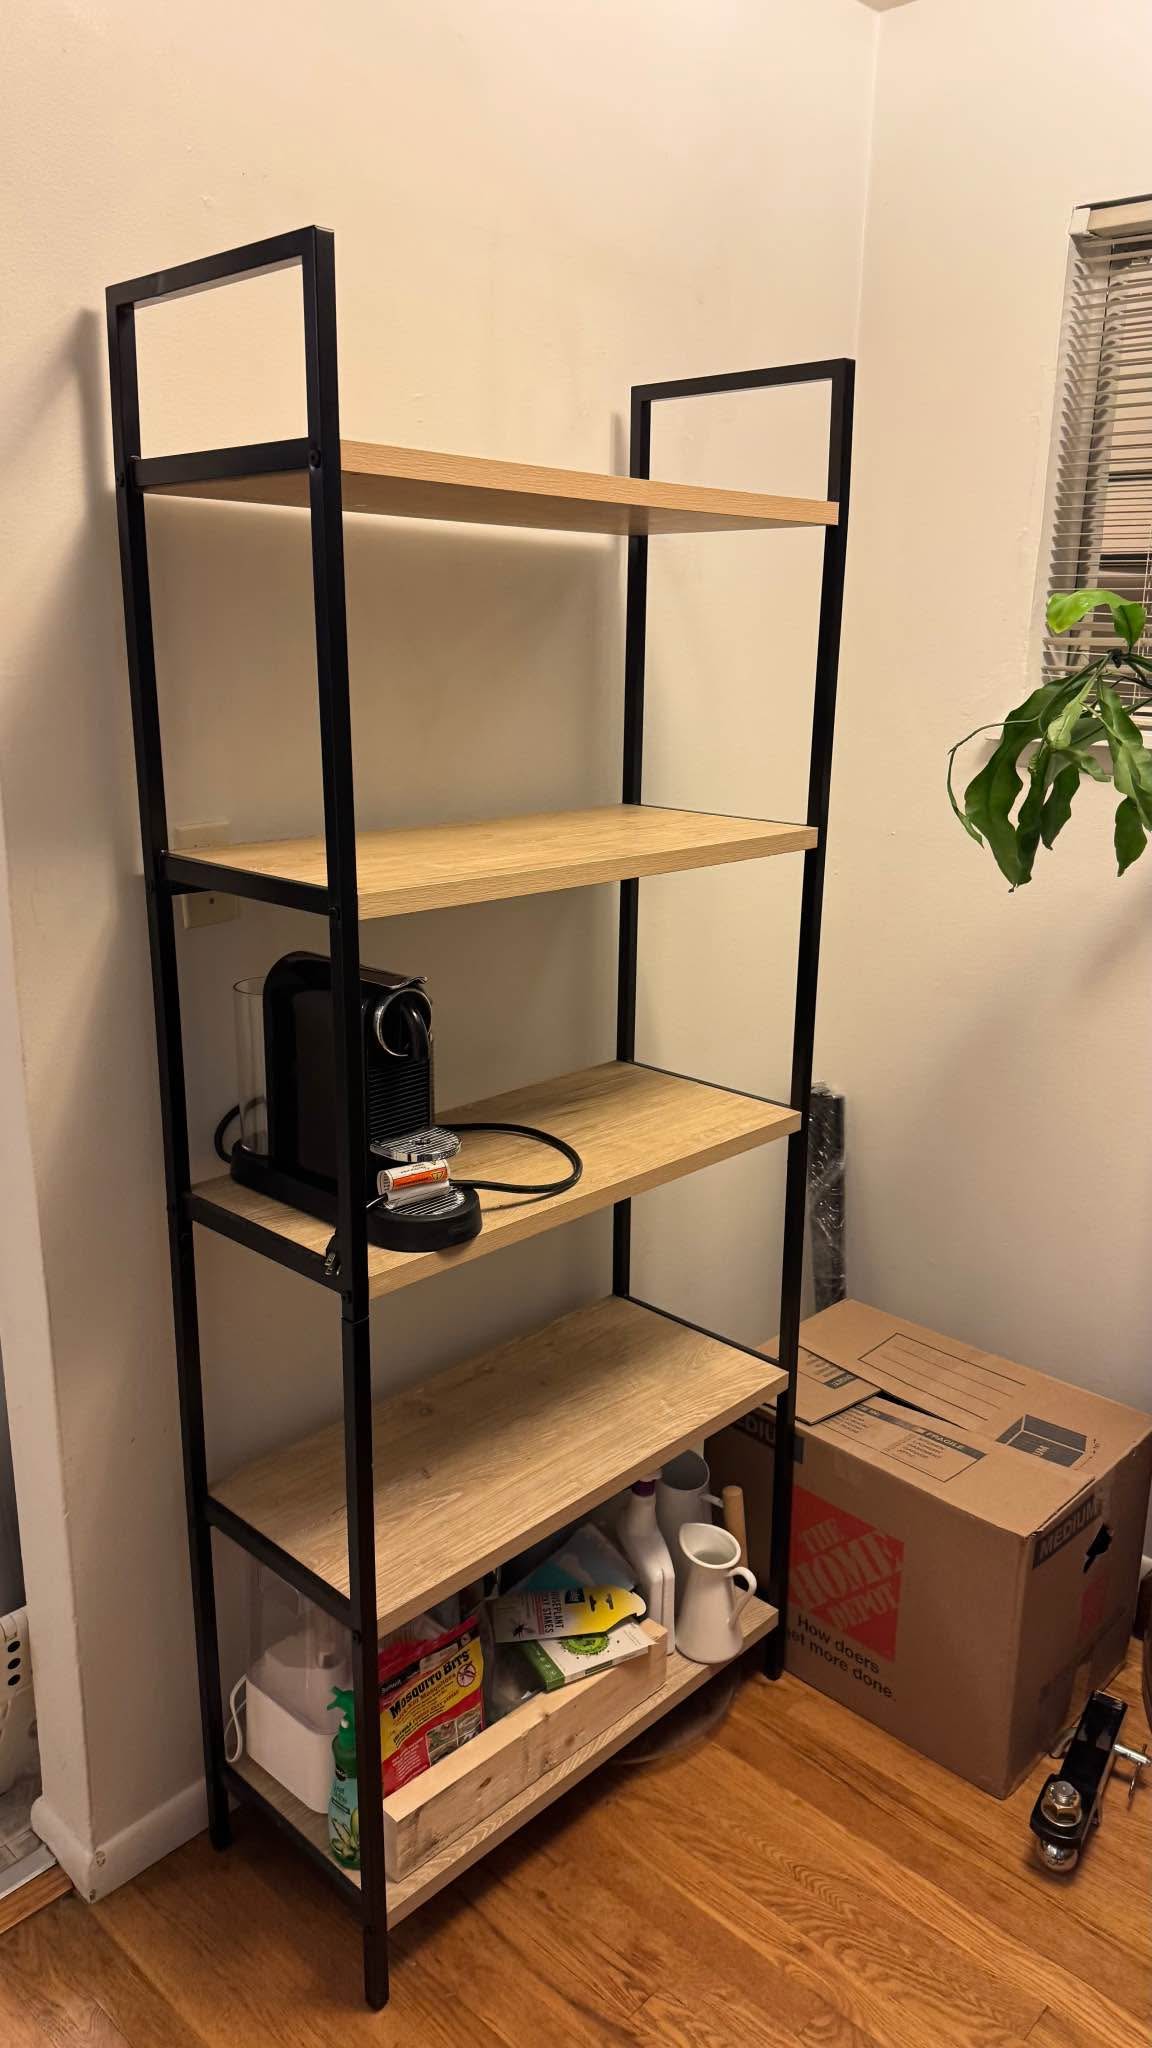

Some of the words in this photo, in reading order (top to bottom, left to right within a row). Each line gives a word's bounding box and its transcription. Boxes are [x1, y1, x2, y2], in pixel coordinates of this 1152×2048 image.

[925, 1430, 963, 1449] FRAGILE
[801, 1518, 839, 1554] THE
[1039, 1498, 1098, 1559] MEDIUM
[789, 1531, 904, 1604] HOME
[543, 1608, 554, 1633] STAKES
[827, 1583, 900, 1630] DEPOT
[798, 1615, 831, 1643] How
[835, 1639, 880, 1674] doers
[809, 1640, 849, 1672] more
[852, 1666, 893, 1698] done
